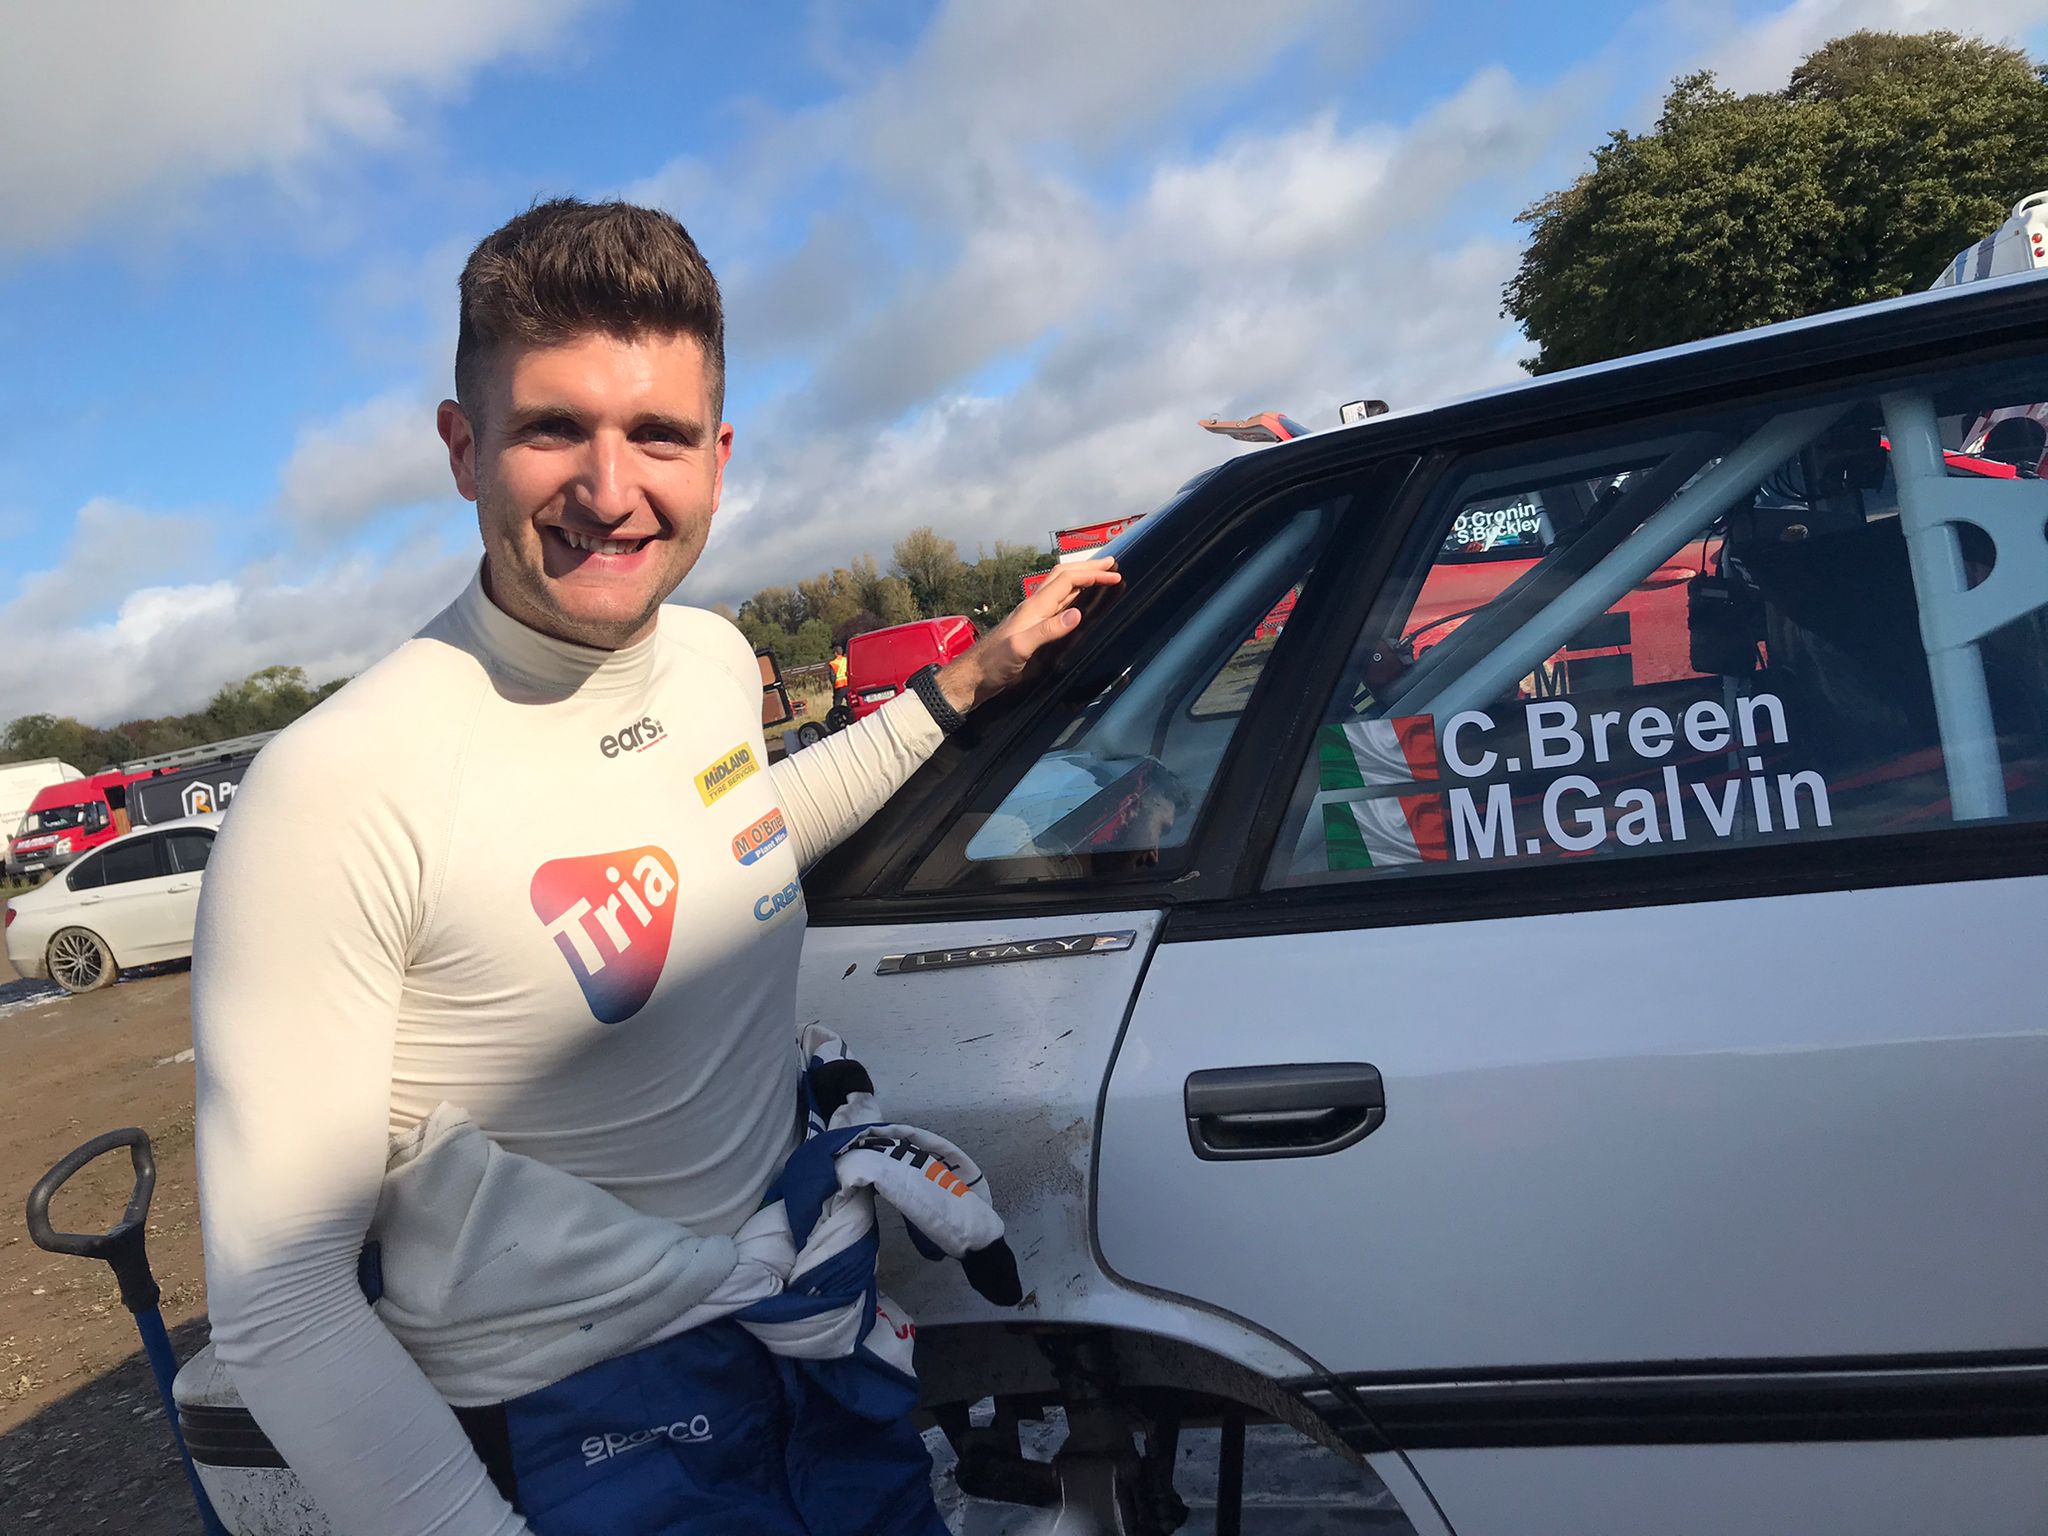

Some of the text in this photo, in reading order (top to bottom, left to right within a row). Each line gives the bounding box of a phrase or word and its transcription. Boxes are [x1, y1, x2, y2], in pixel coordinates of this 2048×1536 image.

[1453, 503, 1536, 531] D.Cronin
[1442, 693, 1789, 778] C.Breen
[728, 764, 756, 788] SERVICES
[1449, 756, 1832, 861] M.Galvin
[735, 835, 751, 856] M
[755, 839, 776, 858] Plant
[544, 855, 676, 977] Tria
[915, 938, 1082, 965] LEGACY
